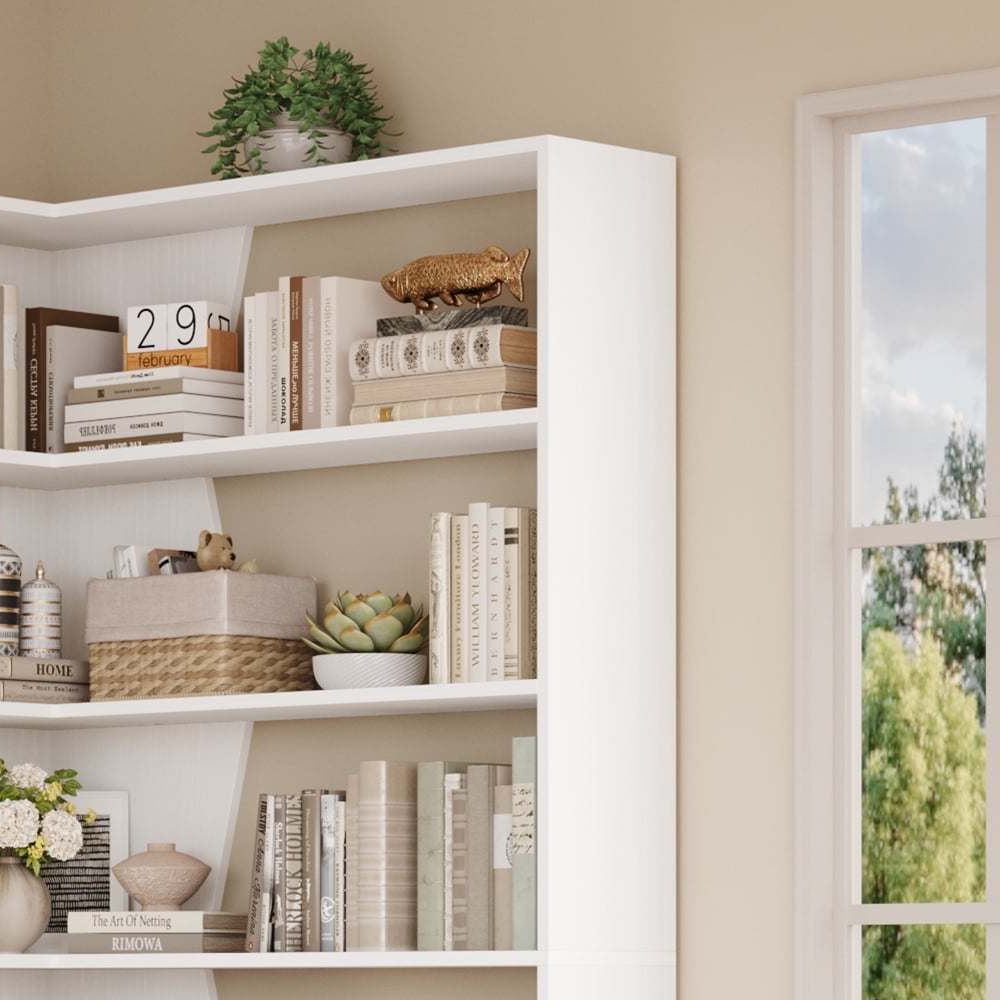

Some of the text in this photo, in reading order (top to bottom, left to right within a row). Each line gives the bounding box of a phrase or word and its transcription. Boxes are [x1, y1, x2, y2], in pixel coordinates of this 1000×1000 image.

[137, 351, 193, 369] february
[323, 296, 334, 417] НОВЫЙ ОБРАЗ ЖИЗНИ
[270, 364, 279, 424] ПРЕДАННЫХ
[454, 523, 462, 679] Luxury Furniture London
[471, 523, 480, 668] WILLIAM YEOWARD
[490, 521, 498, 677] BERNHARDT
[35, 662, 74, 678] HOME
[285, 794, 303, 861] HOLMES
[91, 914, 172, 930] The Art Of Netting
[111, 936, 164, 952] RIMOWA
